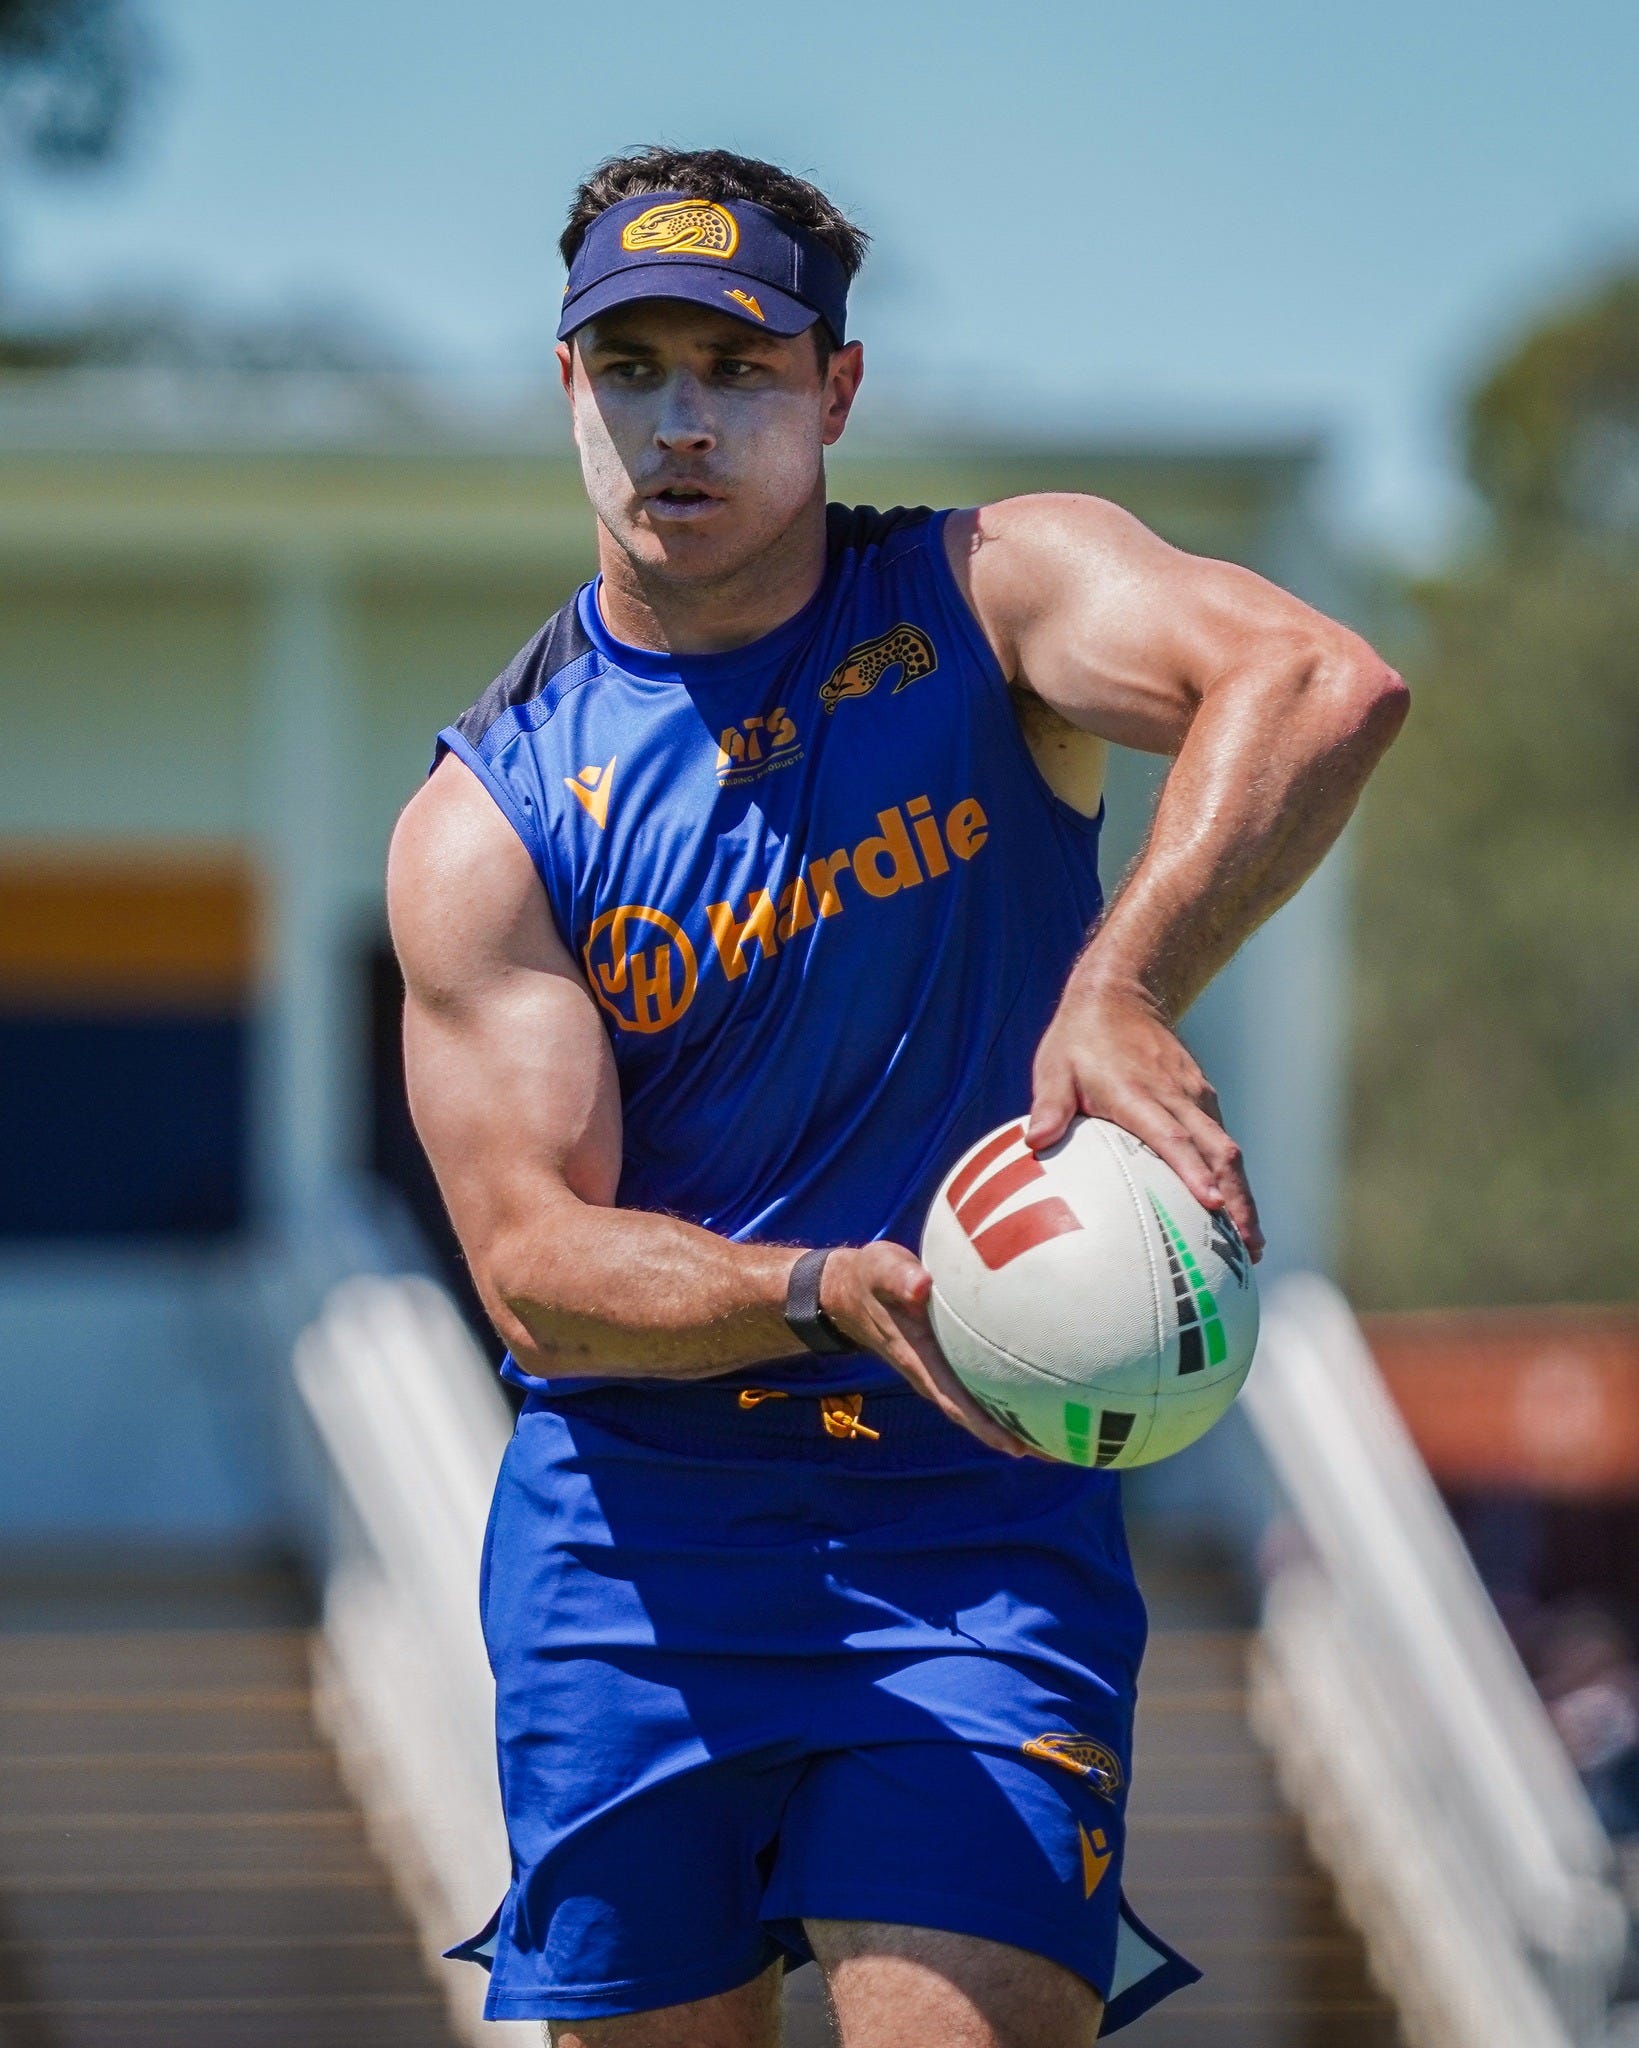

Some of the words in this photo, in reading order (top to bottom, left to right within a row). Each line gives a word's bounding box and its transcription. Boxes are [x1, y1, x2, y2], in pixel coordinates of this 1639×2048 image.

[716, 707, 797, 770] ATS
[718, 775, 755, 787] BUDING
[757, 751, 804, 779] ODUCTS
[706, 795, 989, 981] Hardie
